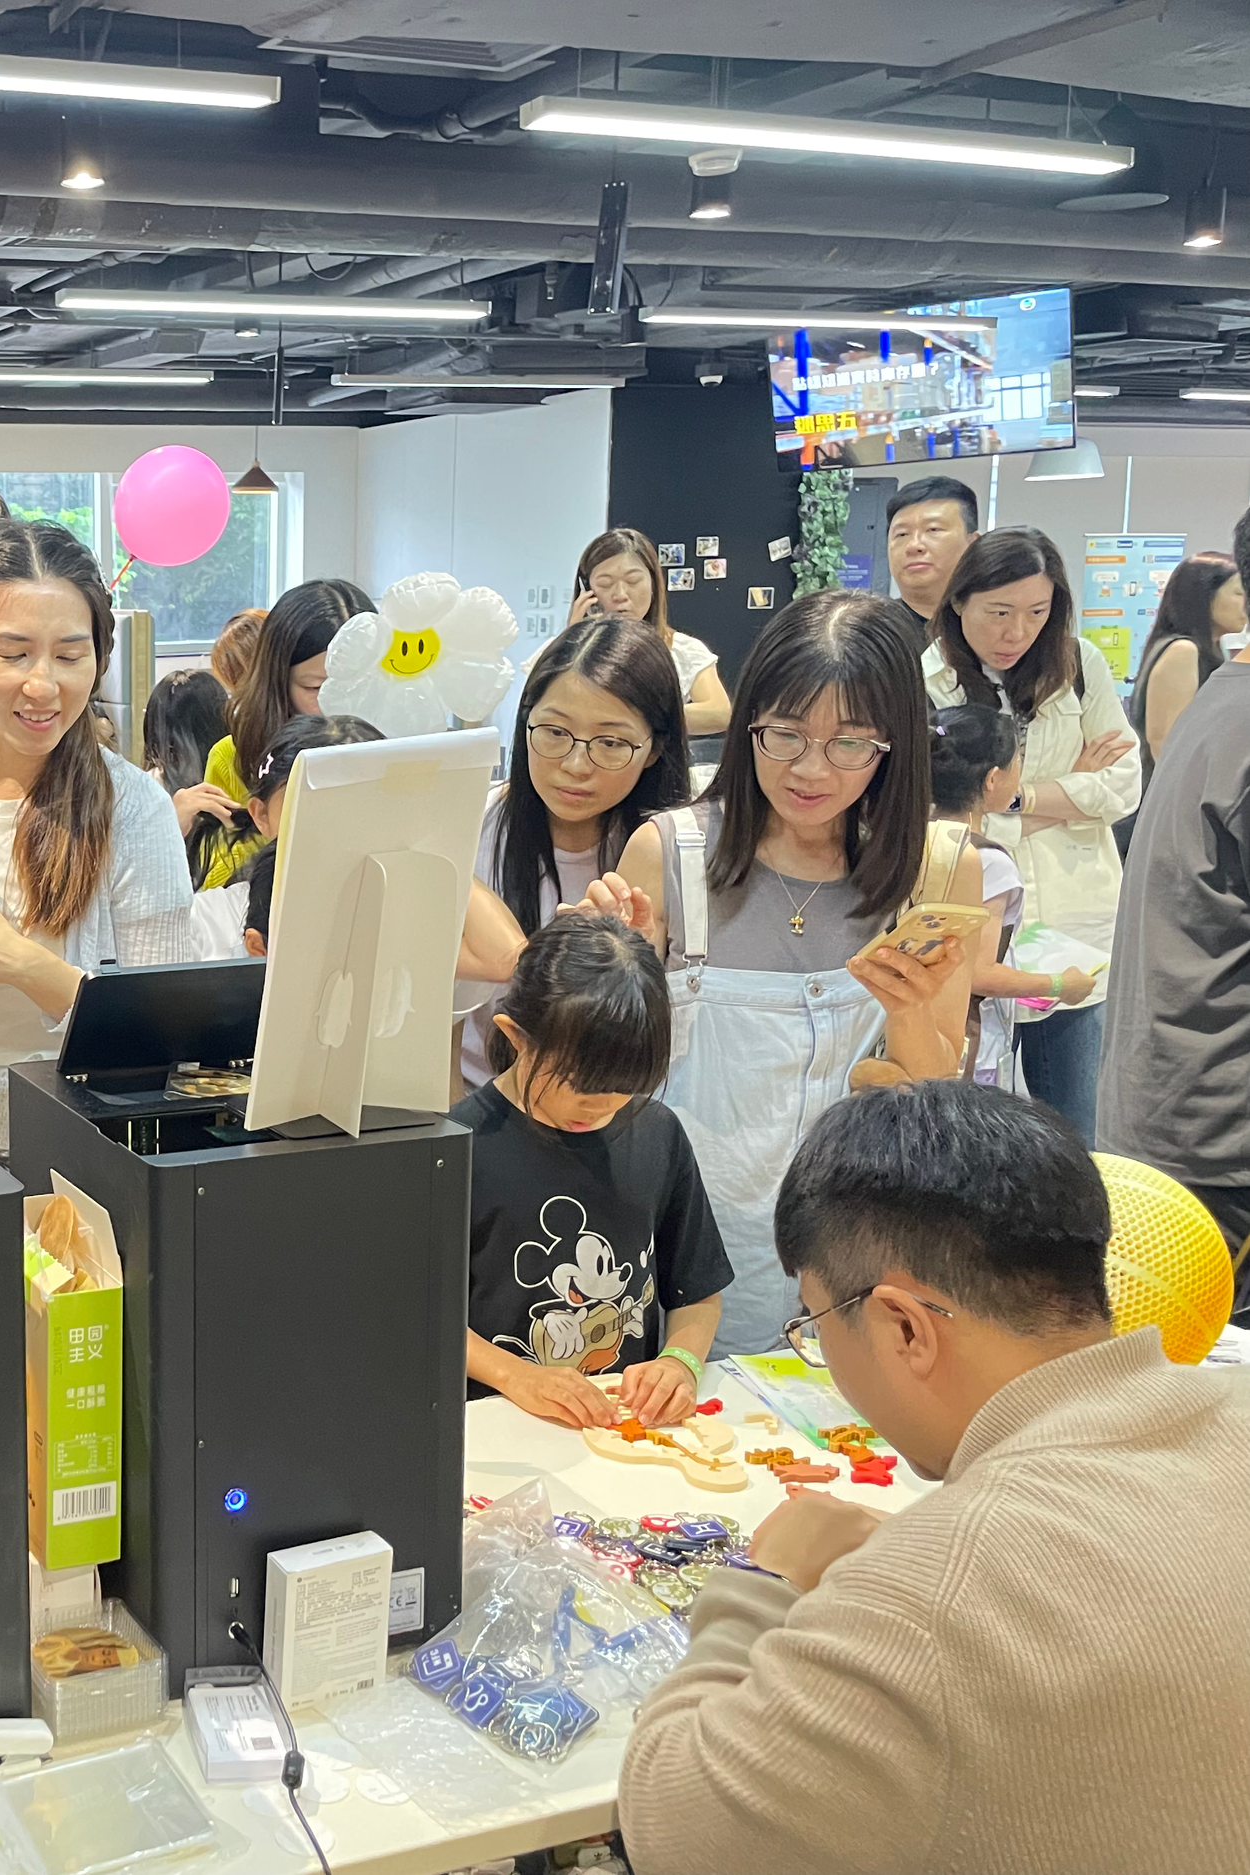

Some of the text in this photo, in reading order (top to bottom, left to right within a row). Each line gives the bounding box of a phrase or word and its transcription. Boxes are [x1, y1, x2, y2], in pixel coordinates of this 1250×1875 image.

[794, 410, 857, 435] 迷思五
[69, 1325, 103, 1344] 田园
